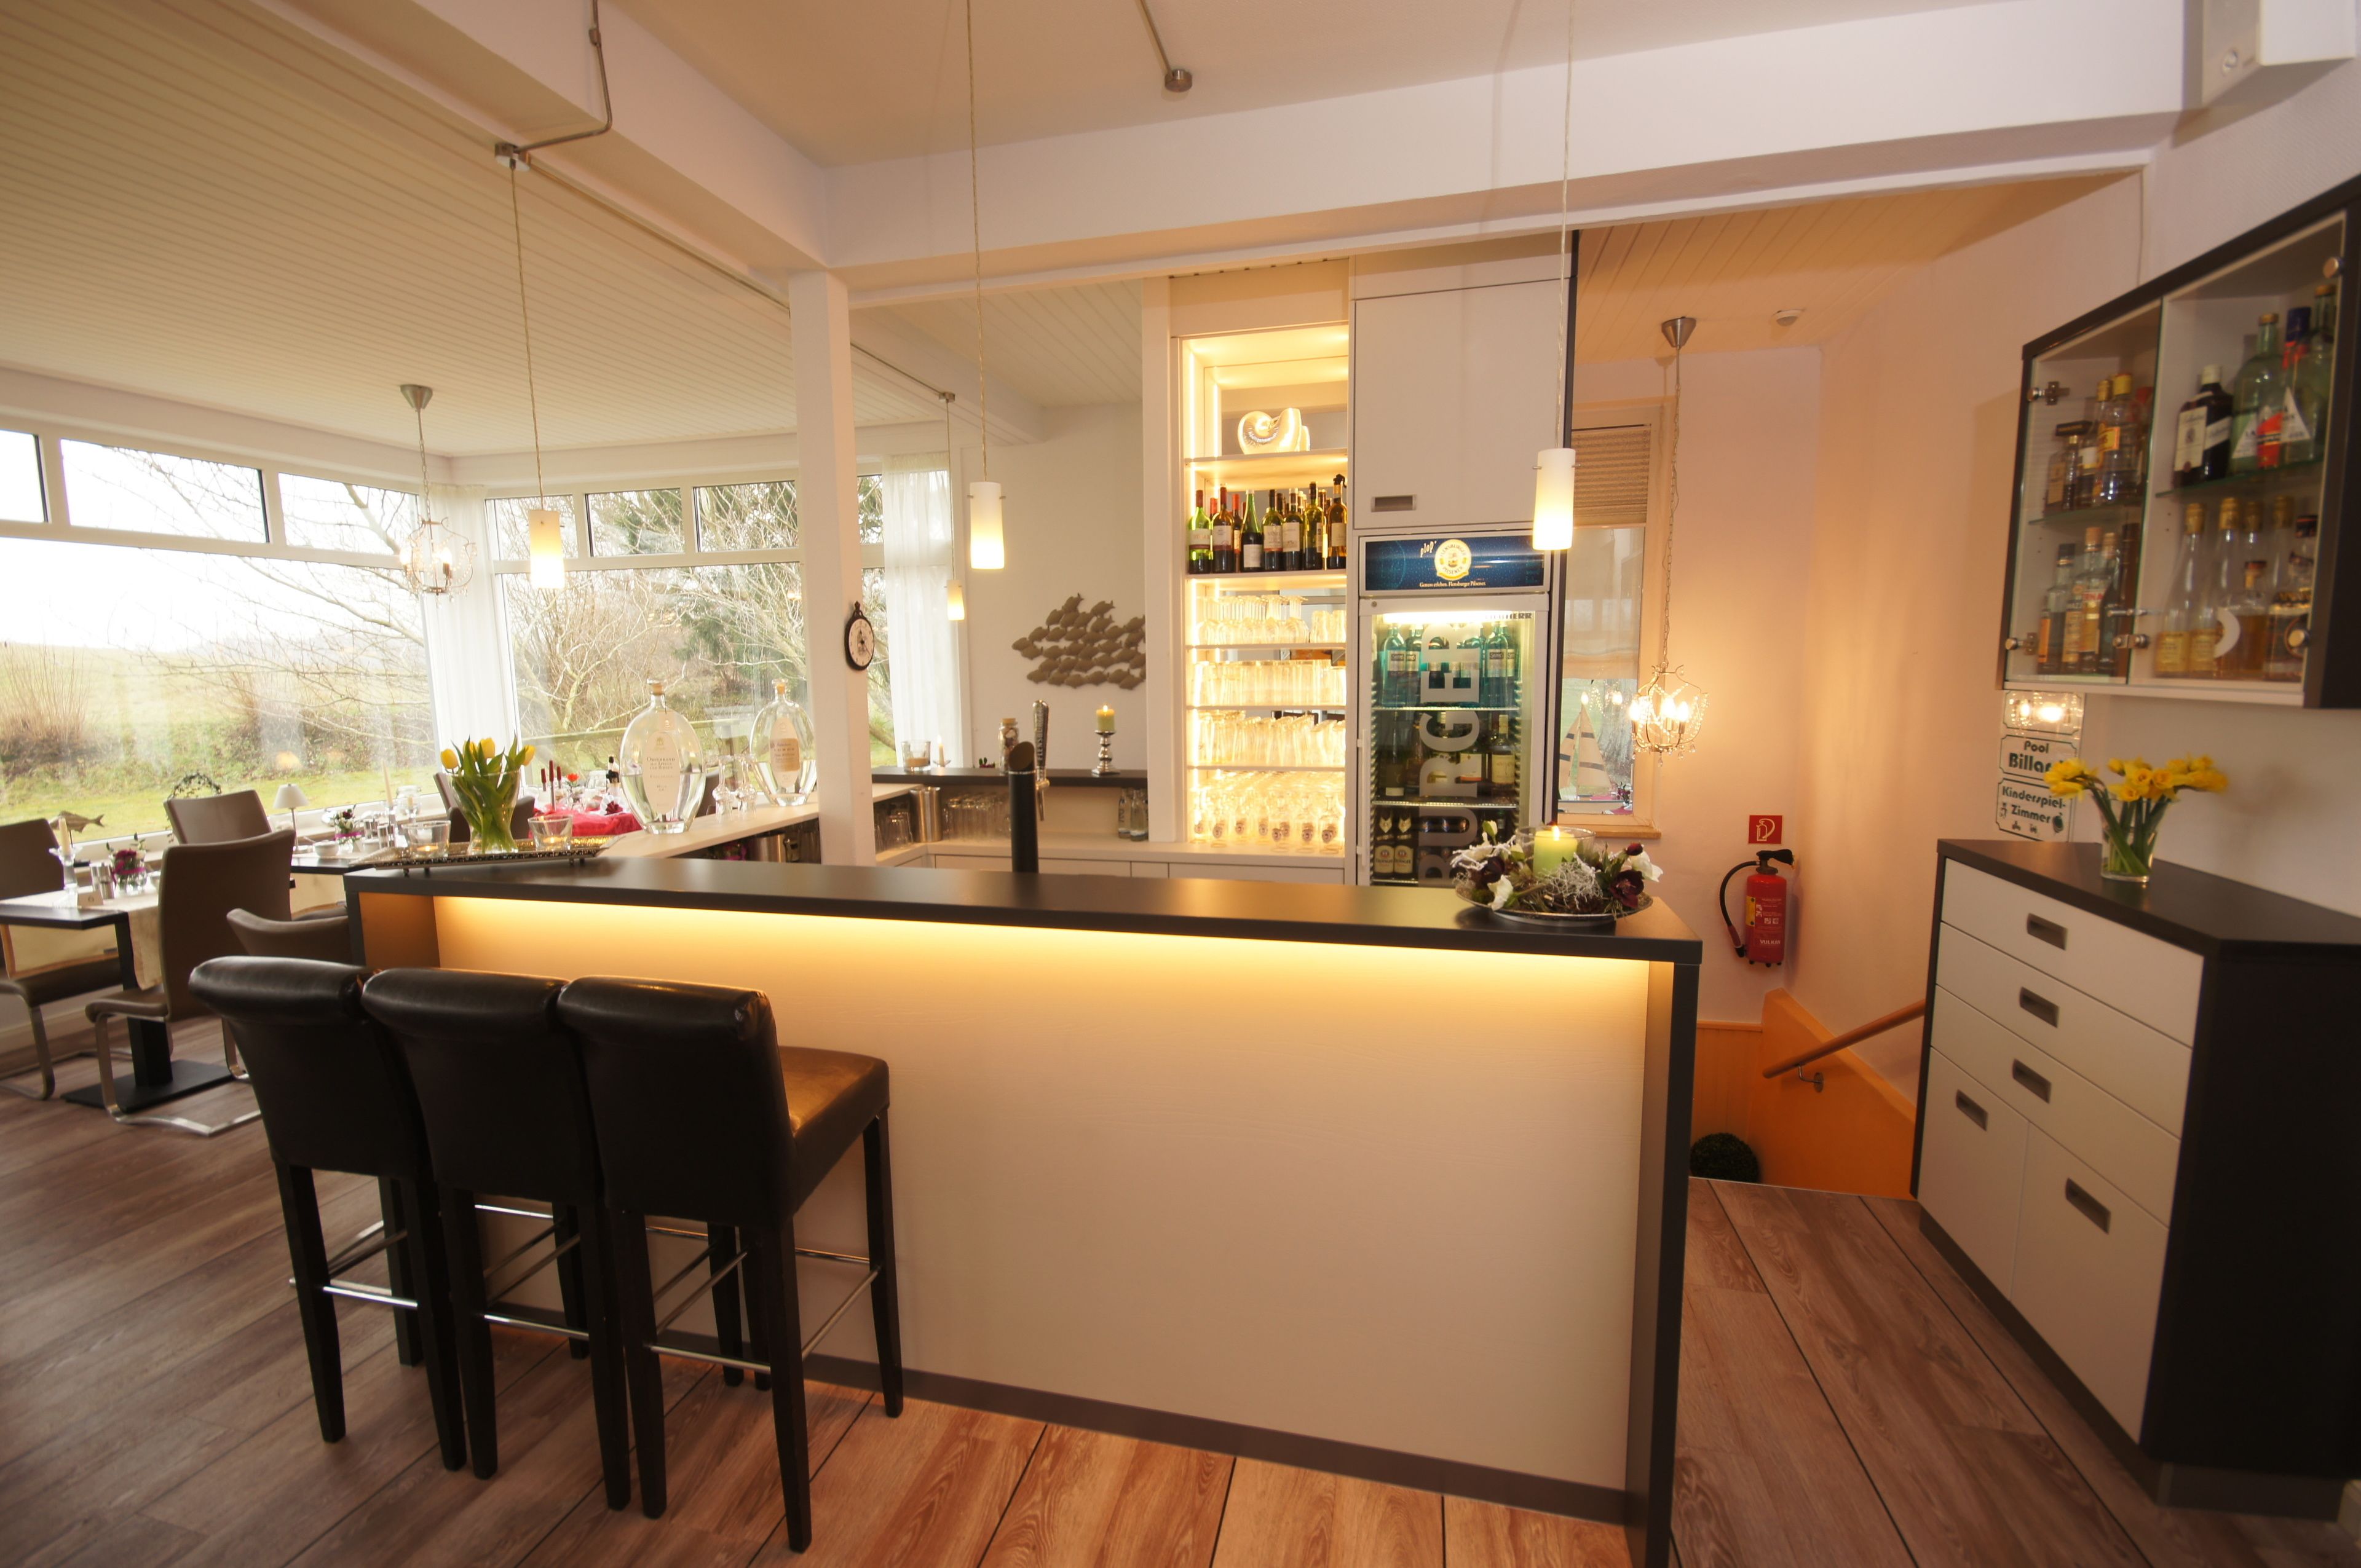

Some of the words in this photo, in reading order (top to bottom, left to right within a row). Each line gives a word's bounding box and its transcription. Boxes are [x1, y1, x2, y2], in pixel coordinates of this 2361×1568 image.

[2024, 740, 2049, 754] Pool
[2009, 752, 2061, 773] Billar
[2002, 786, 2066, 808] Kinderspiel-
[2011, 804, 2051, 824] Zimmer
